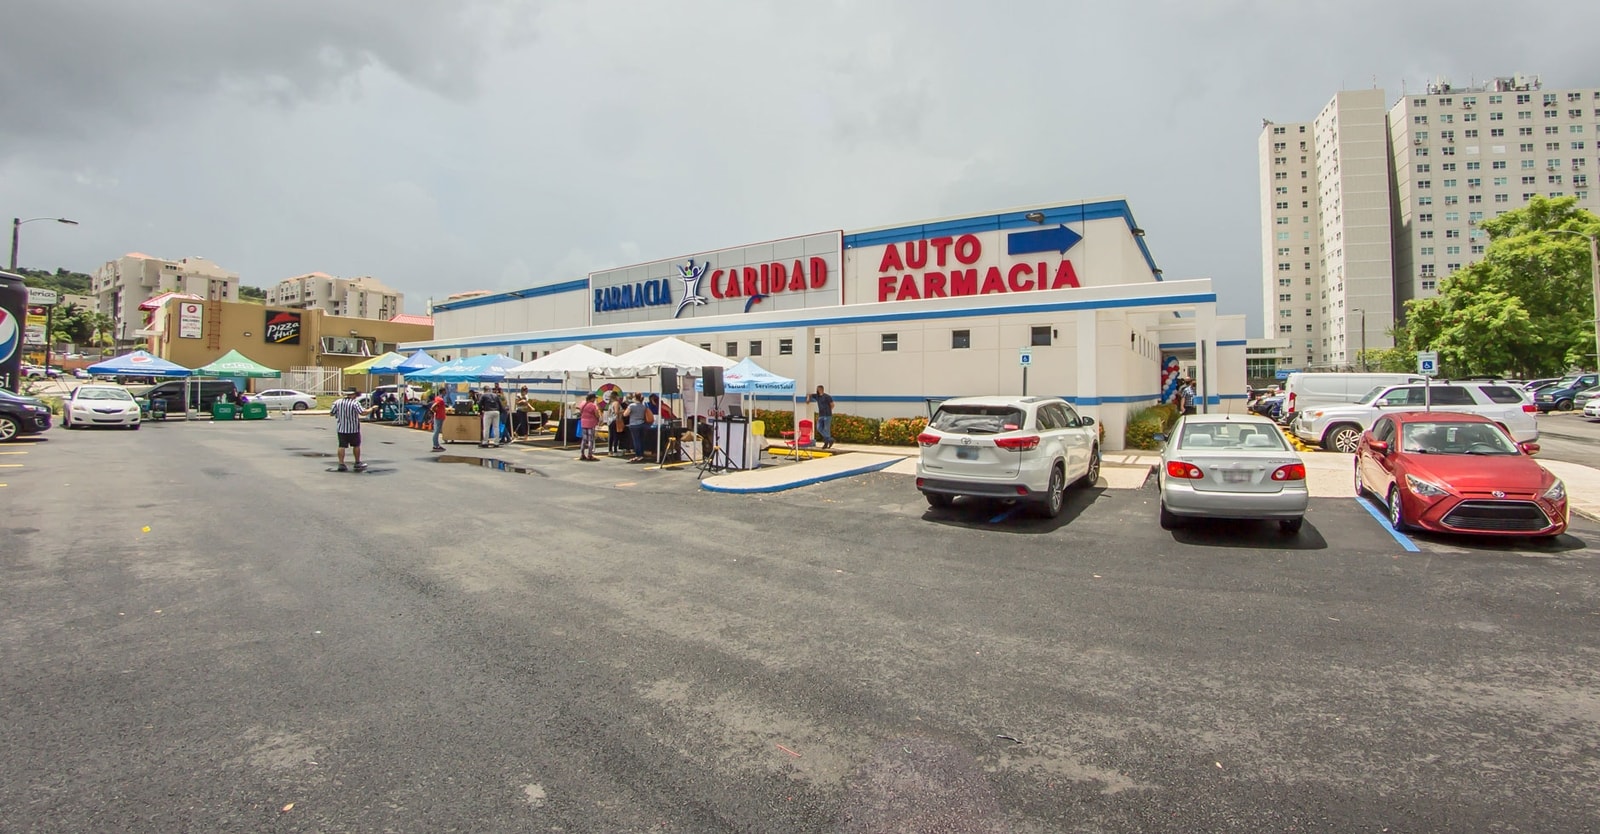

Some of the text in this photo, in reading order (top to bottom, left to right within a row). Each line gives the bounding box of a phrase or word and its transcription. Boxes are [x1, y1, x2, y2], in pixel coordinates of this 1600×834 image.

[879, 234, 981, 272] AUTO
[594, 257, 827, 313] FARMACIA CARIDAD
[878, 260, 1080, 302] FARMACIA
[266, 322, 299, 338] Pizza
[273, 328, 296, 340] Hut
